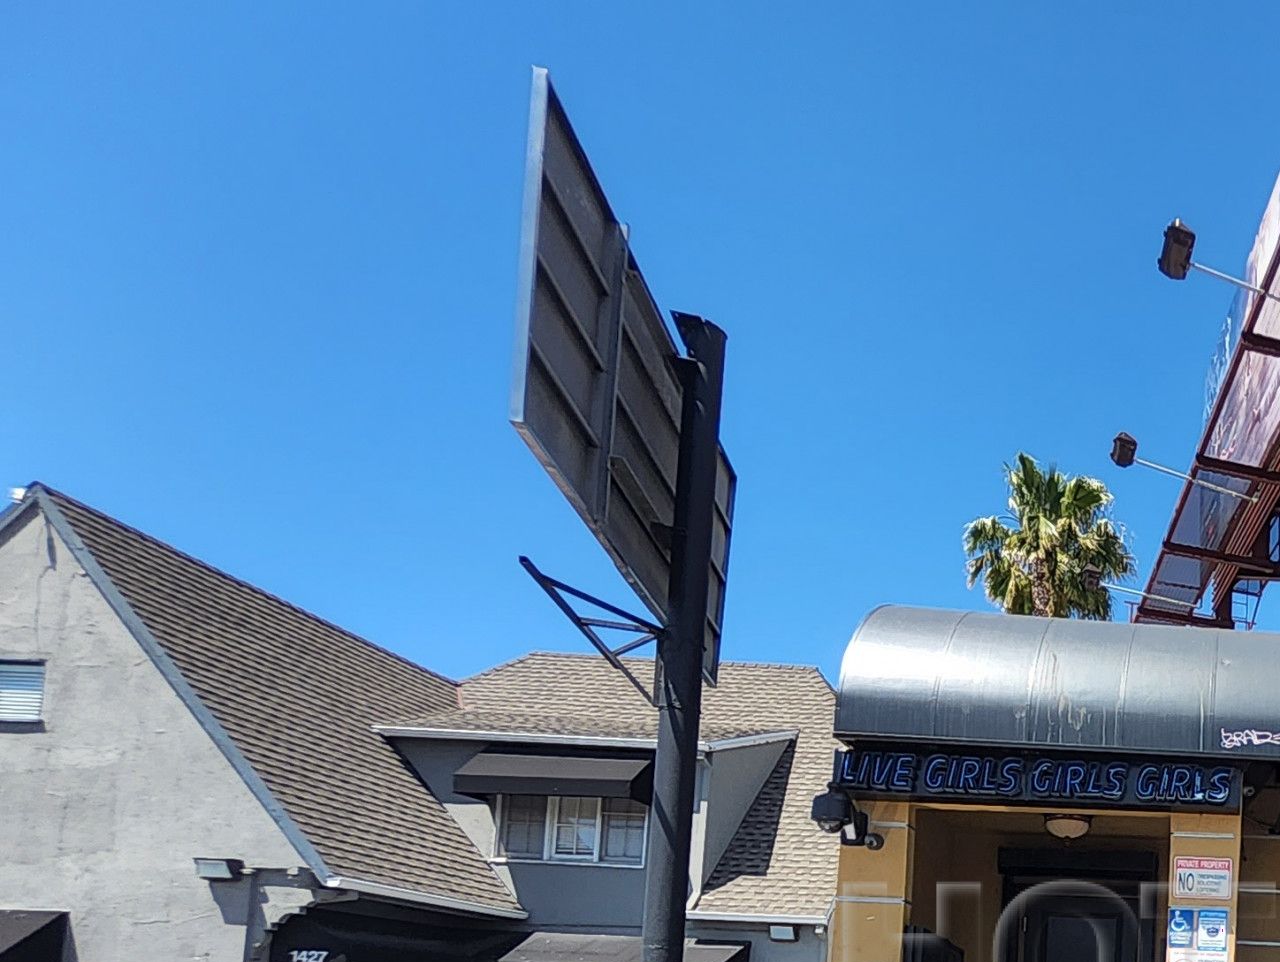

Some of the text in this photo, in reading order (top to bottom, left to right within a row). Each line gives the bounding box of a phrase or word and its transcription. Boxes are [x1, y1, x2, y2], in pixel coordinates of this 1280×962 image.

[841, 751, 1232, 804] LIVE GIRLS GIRLS GIRLS
[1177, 860, 1229, 869] PRIVATE PROPERTY
[1178, 872, 1195, 892] NO
